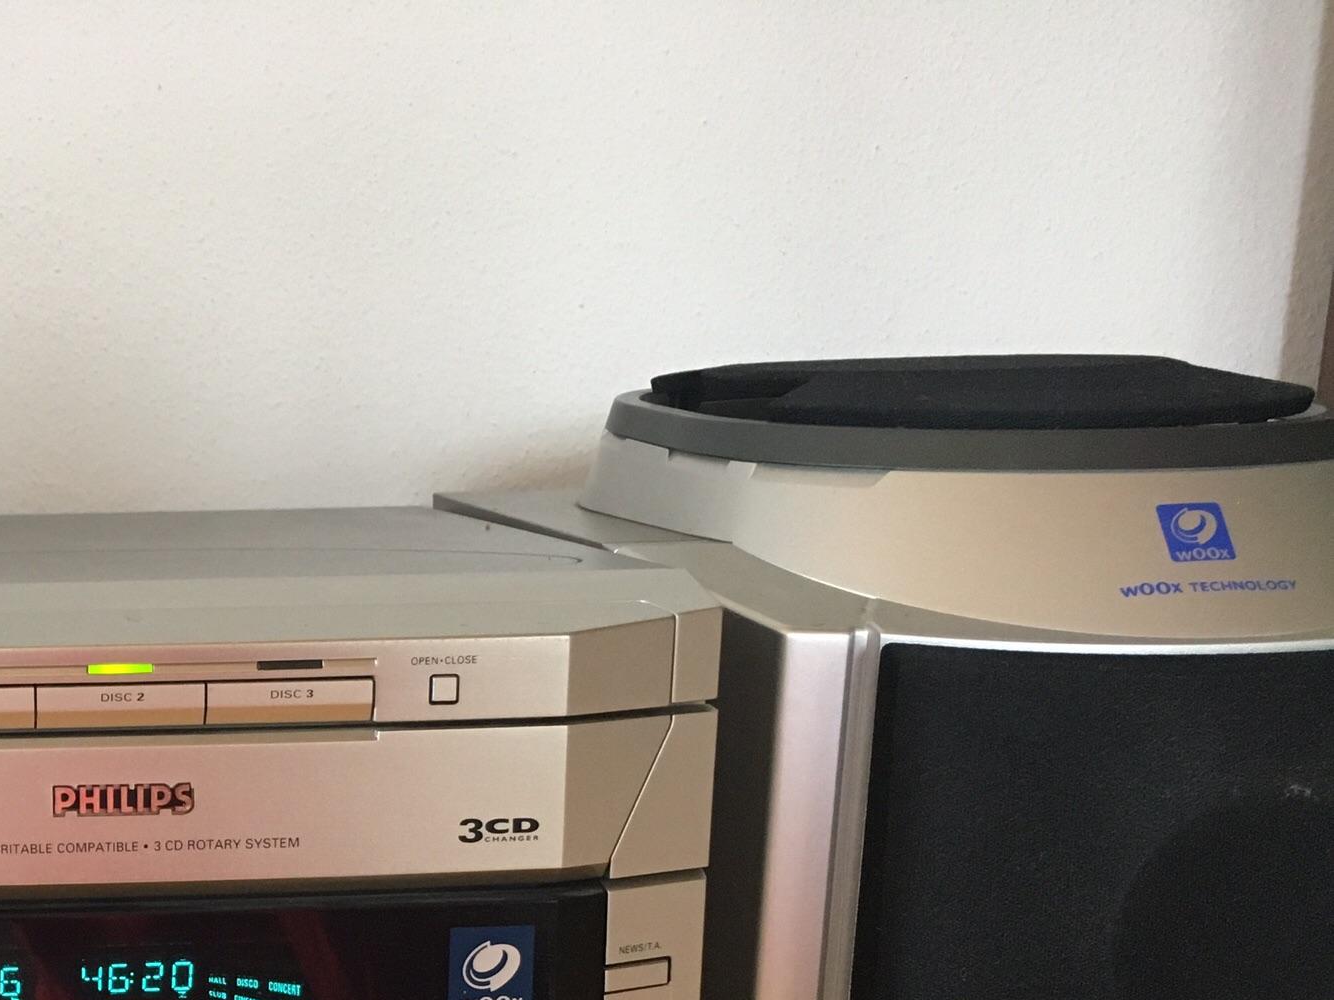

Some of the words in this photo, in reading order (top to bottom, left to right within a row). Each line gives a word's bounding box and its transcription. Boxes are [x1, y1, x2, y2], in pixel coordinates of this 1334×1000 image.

[1189, 579, 1297, 592] TECHNOLOGY
[100, 692, 133, 702] DISC
[136, 692, 145, 702] 2
[270, 689, 302, 699] DISC
[306, 690, 314, 699] 3
[52, 782, 195, 818] PHILIPS
[458, 816, 540, 844] 3CD
[56, 840, 140, 854] COMPATIBLE
[153, 841, 162, 851] 3
[165, 840, 184, 851] CD
[186, 838, 242, 850] ROTARY
[245, 836, 300, 849] SYSTEM
[484, 834, 539, 844] CHANGER
[81, 961, 194, 993] 46:20
[236, 978, 259, 989] DISCO
[268, 981, 301, 996] CONCERT
[208, 990, 227, 1000] CLUB
